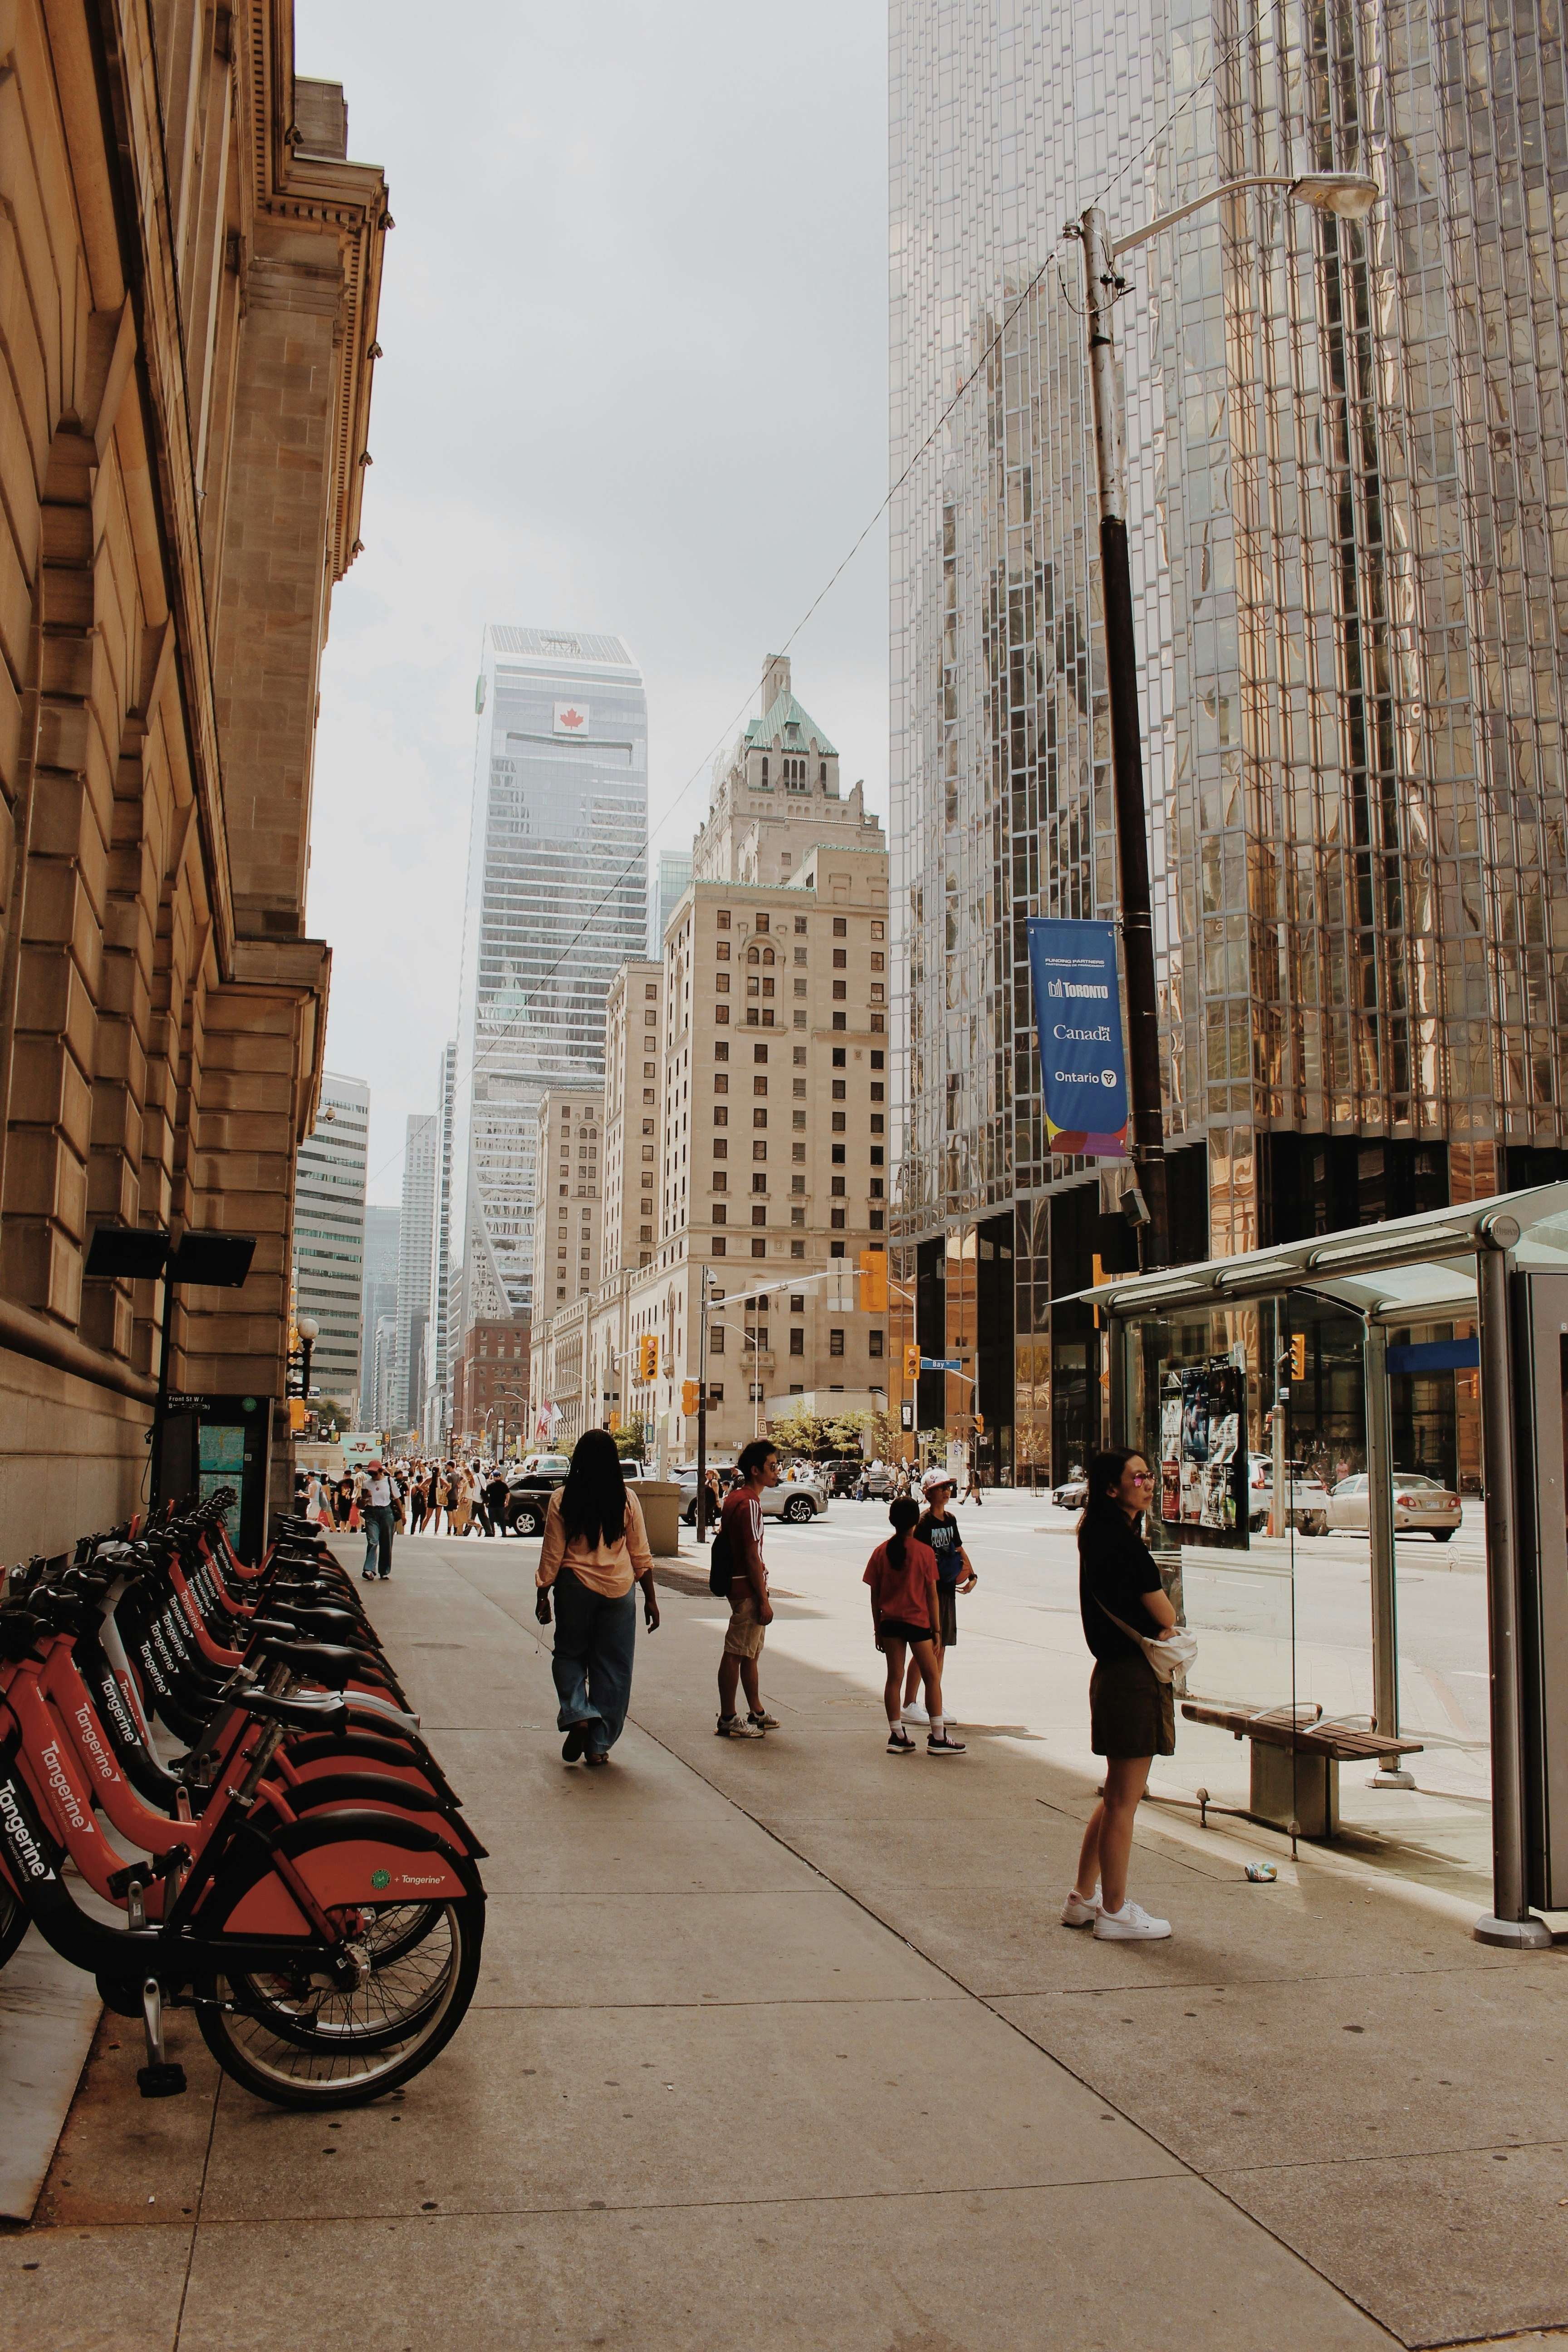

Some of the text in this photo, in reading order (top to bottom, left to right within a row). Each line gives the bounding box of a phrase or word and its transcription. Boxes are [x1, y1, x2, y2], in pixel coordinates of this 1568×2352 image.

[1062, 982, 1108, 999] TORONTO
[1053, 1024, 1111, 1042] Canada
[1055, 1071, 1099, 1083] Ontario
[207, 1561, 221, 1592] Tangerine
[217, 1542, 230, 1571] Tangerine
[186, 1577, 205, 1614] Tangerine
[200, 1564, 216, 1597] Tangerine
[169, 1594, 190, 1636] Tangerine
[180, 1589, 200, 1629] Tangerine
[151, 1620, 174, 1670] Tangerine
[162, 1611, 185, 1657] Tangerine
[140, 1640, 166, 1692] Tangerine
[101, 1674, 134, 1742] Tangerine
[75, 1702, 112, 1778] Tangerine
[41, 1740, 84, 1828] Tangerine
[0, 1779, 45, 1876] Tangerine
[51, 1791, 71, 1833] Forward Banking
[7, 1836, 30, 1882] Forward Banking
[402, 1875, 440, 1885] Tangerine
